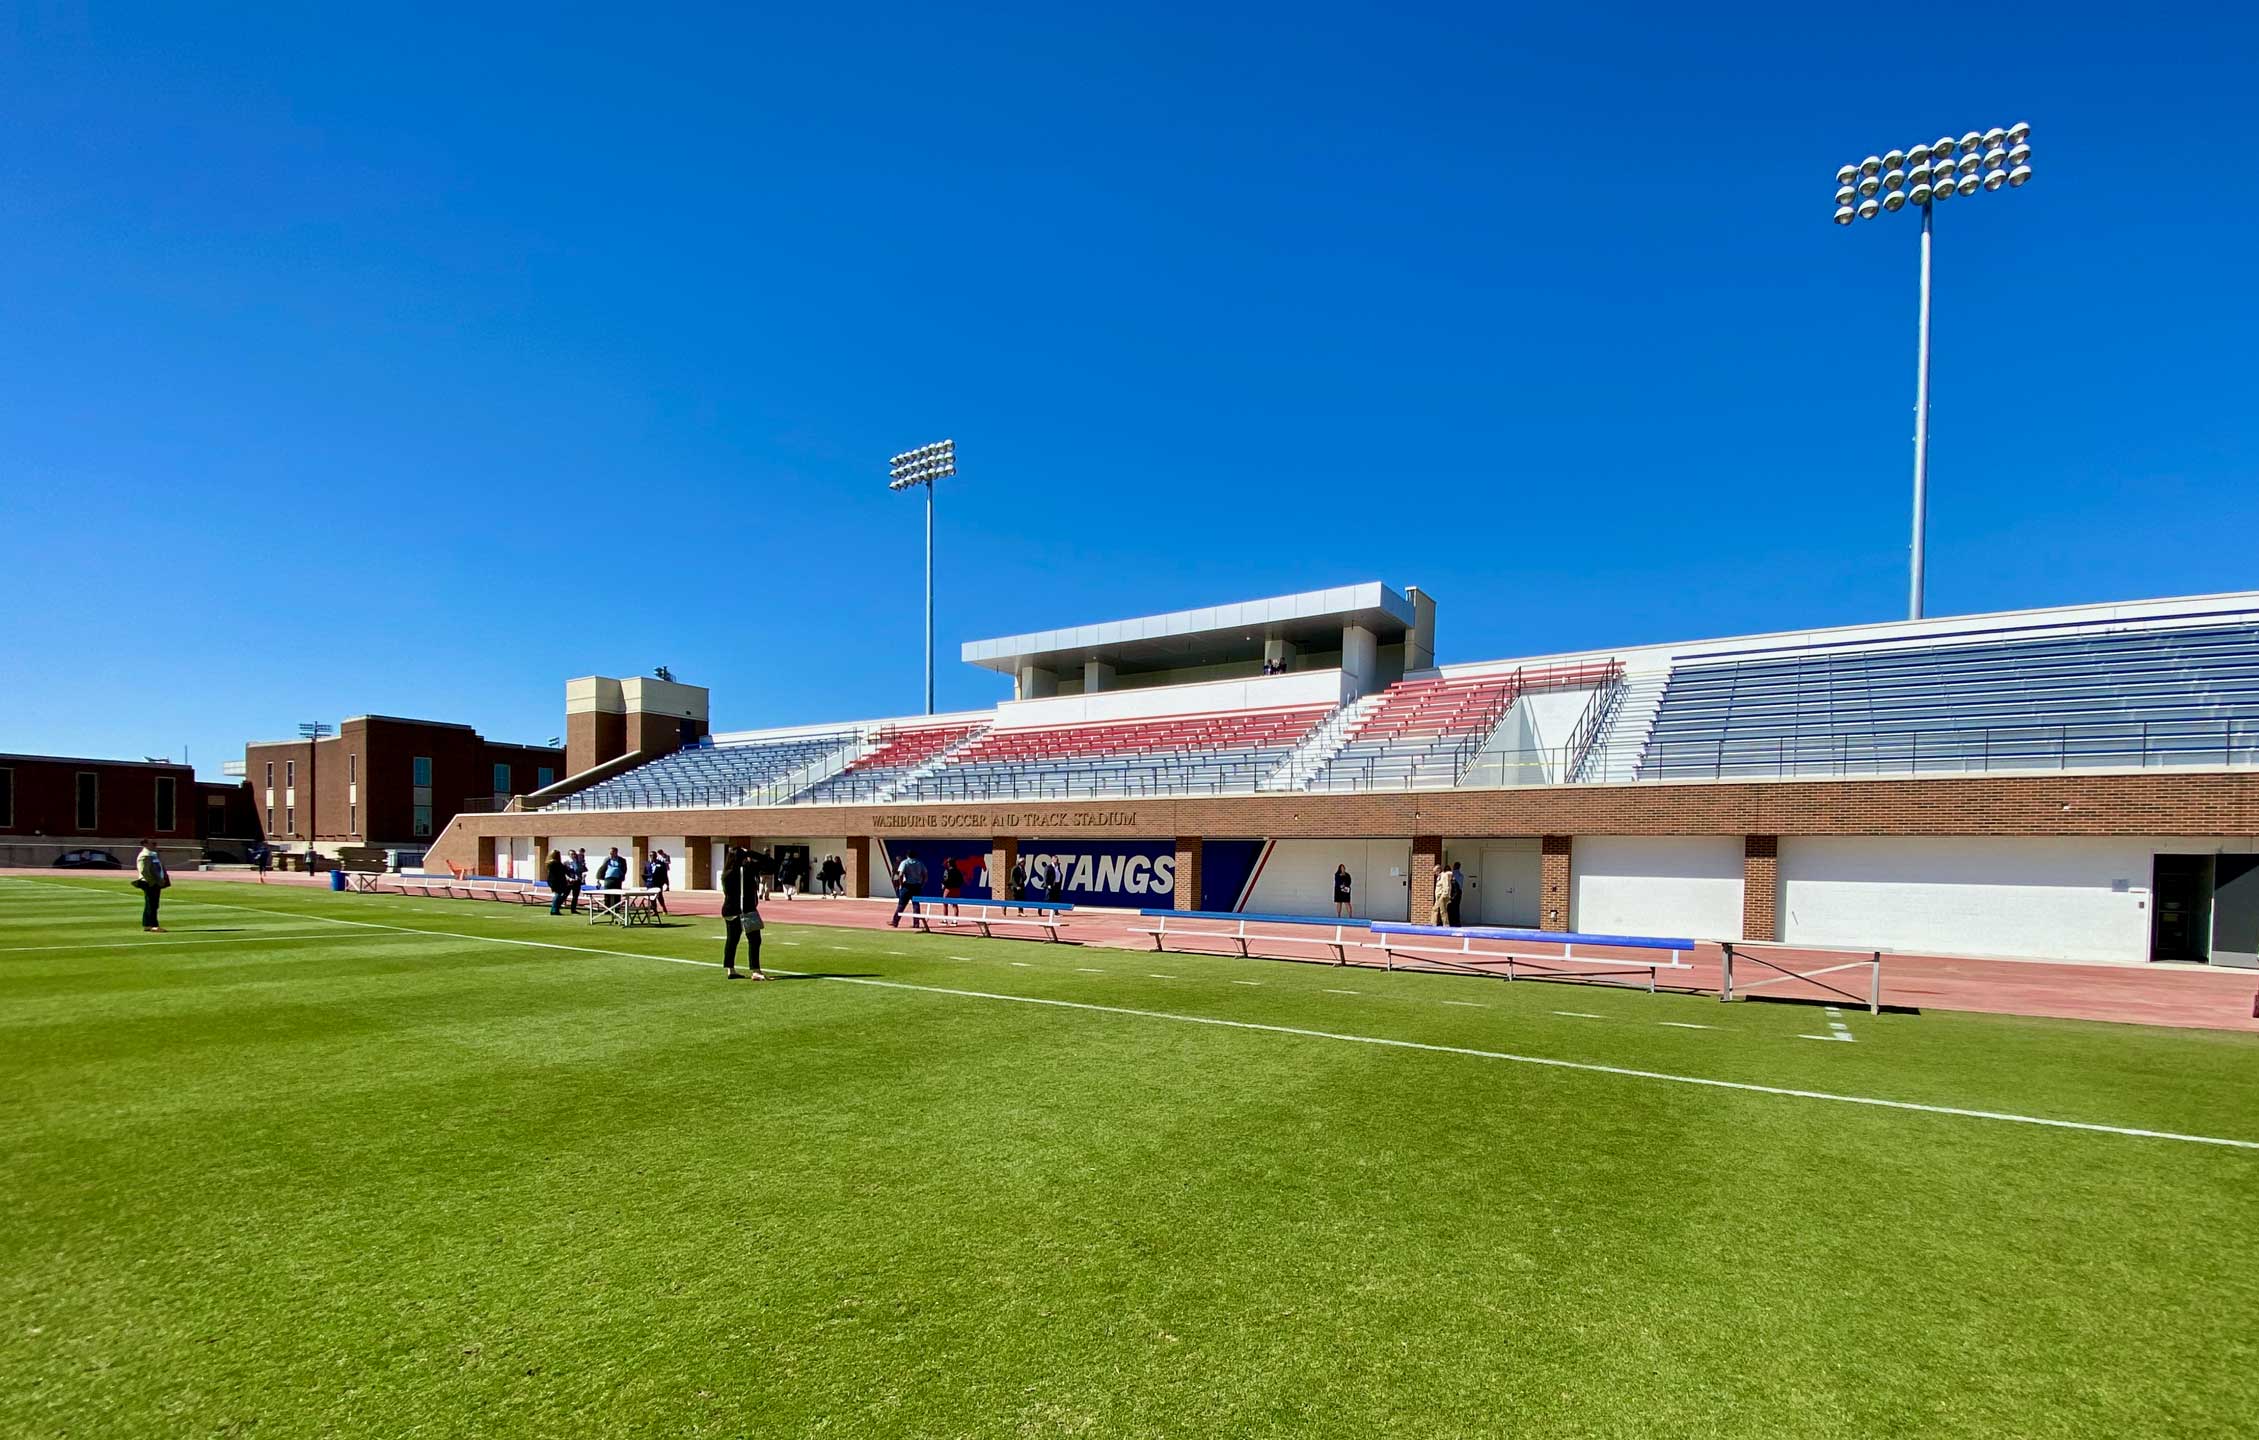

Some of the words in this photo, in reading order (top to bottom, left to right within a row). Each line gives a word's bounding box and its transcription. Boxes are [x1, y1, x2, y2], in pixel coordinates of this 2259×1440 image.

[872, 815, 937, 827] WASHBURNE
[941, 814, 987, 827] SOCCER
[992, 814, 1020, 827] AND
[1023, 812, 1069, 827] TRACK
[1073, 811, 1137, 826] STADIUM
